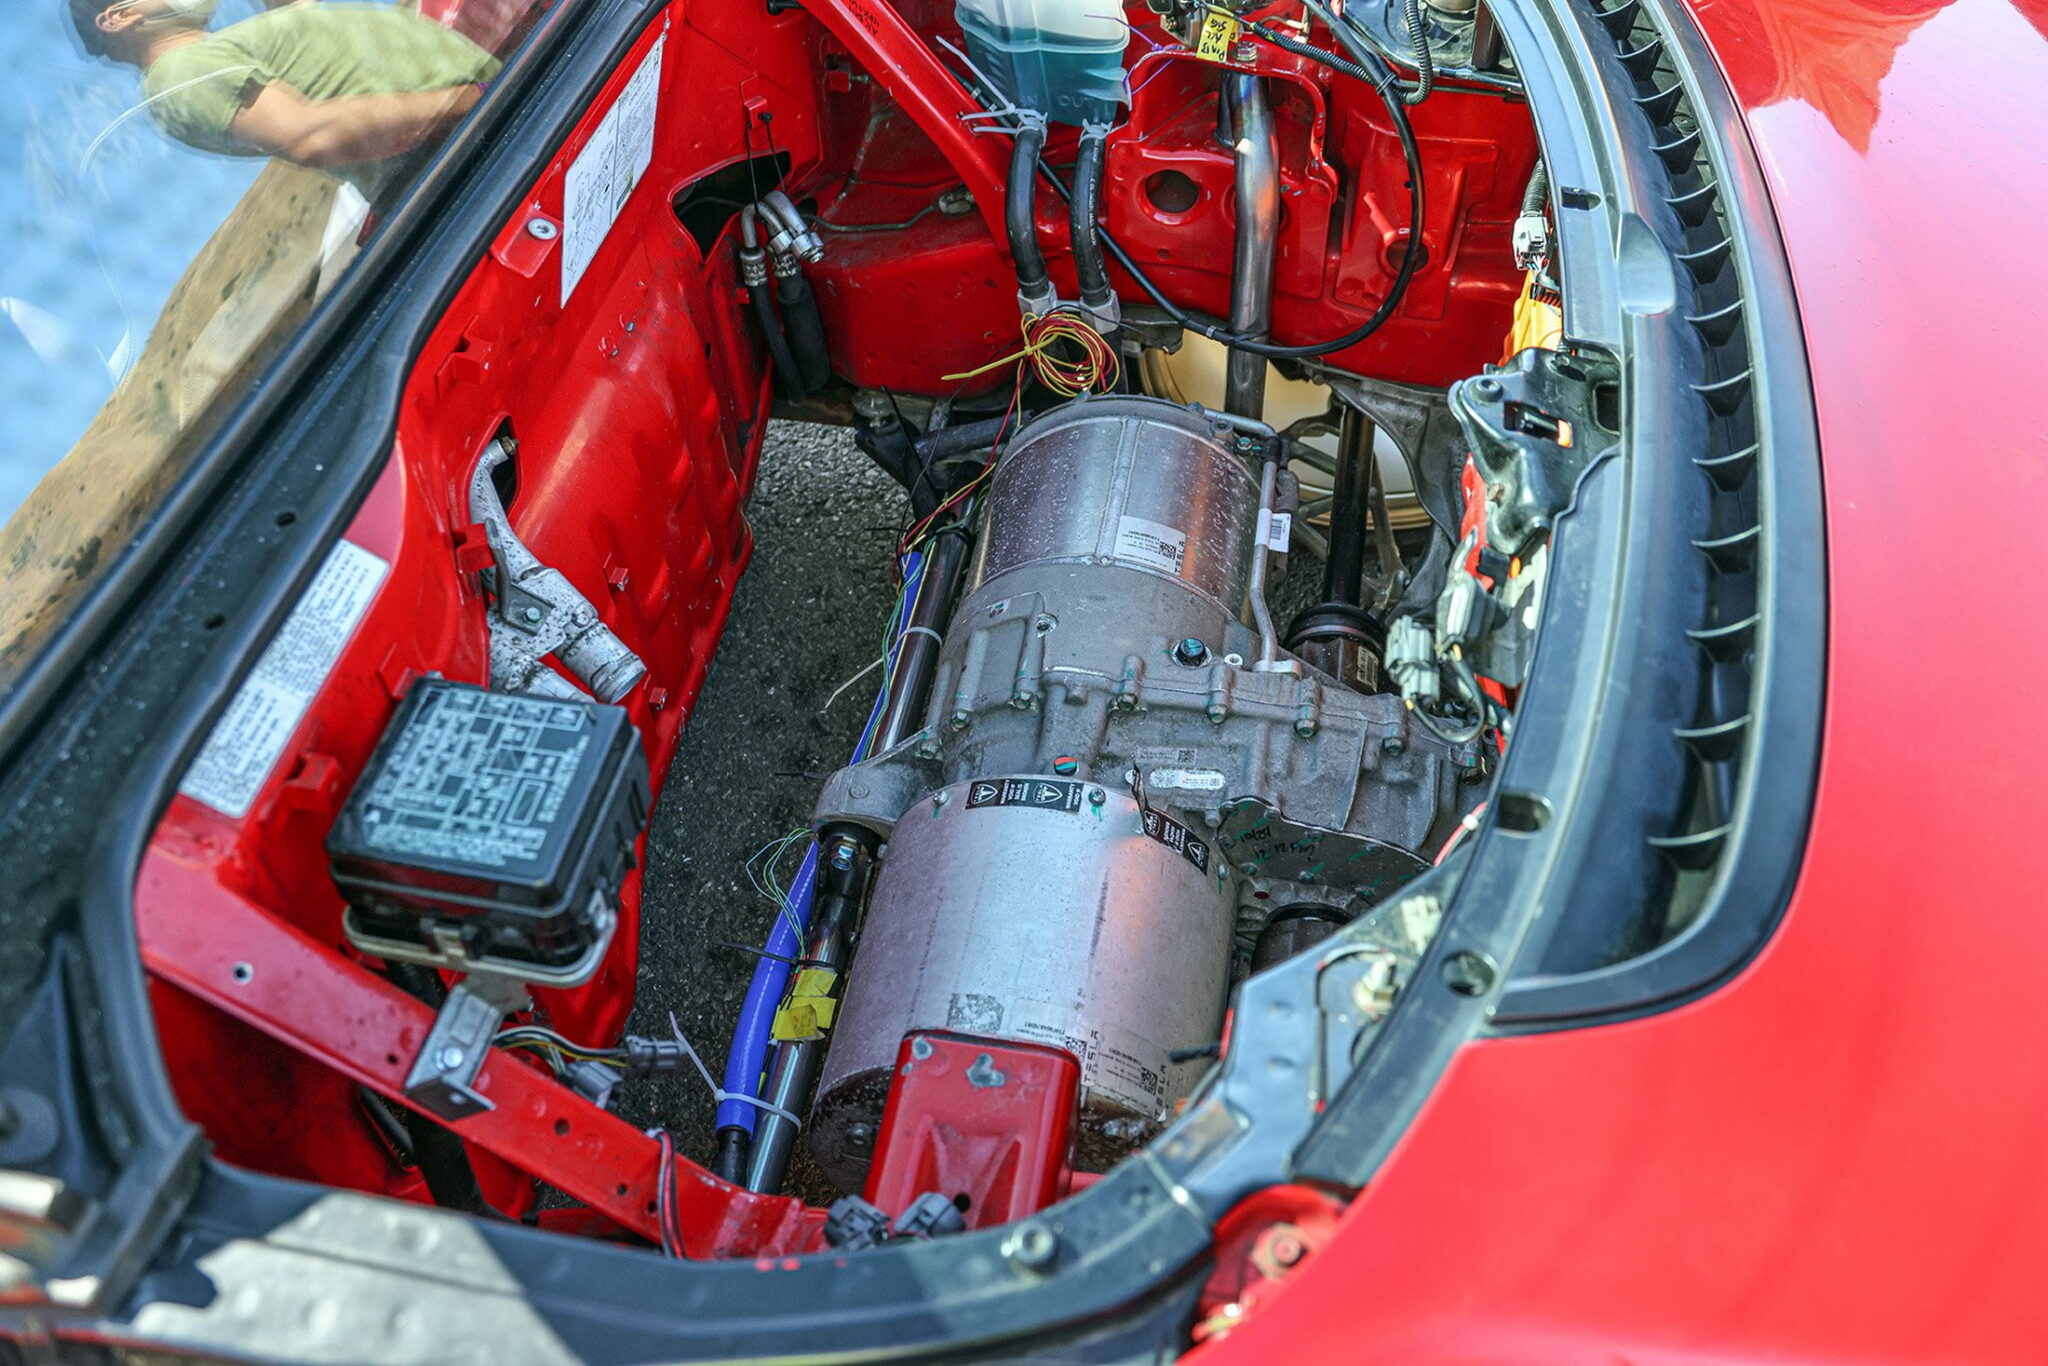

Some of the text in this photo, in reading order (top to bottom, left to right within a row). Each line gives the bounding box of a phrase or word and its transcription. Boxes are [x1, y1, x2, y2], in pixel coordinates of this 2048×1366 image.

[1057, 94, 1095, 109] OUT
[1084, 1030, 1099, 1083] TESLA
[1155, 1064, 1167, 1119] TESLA
